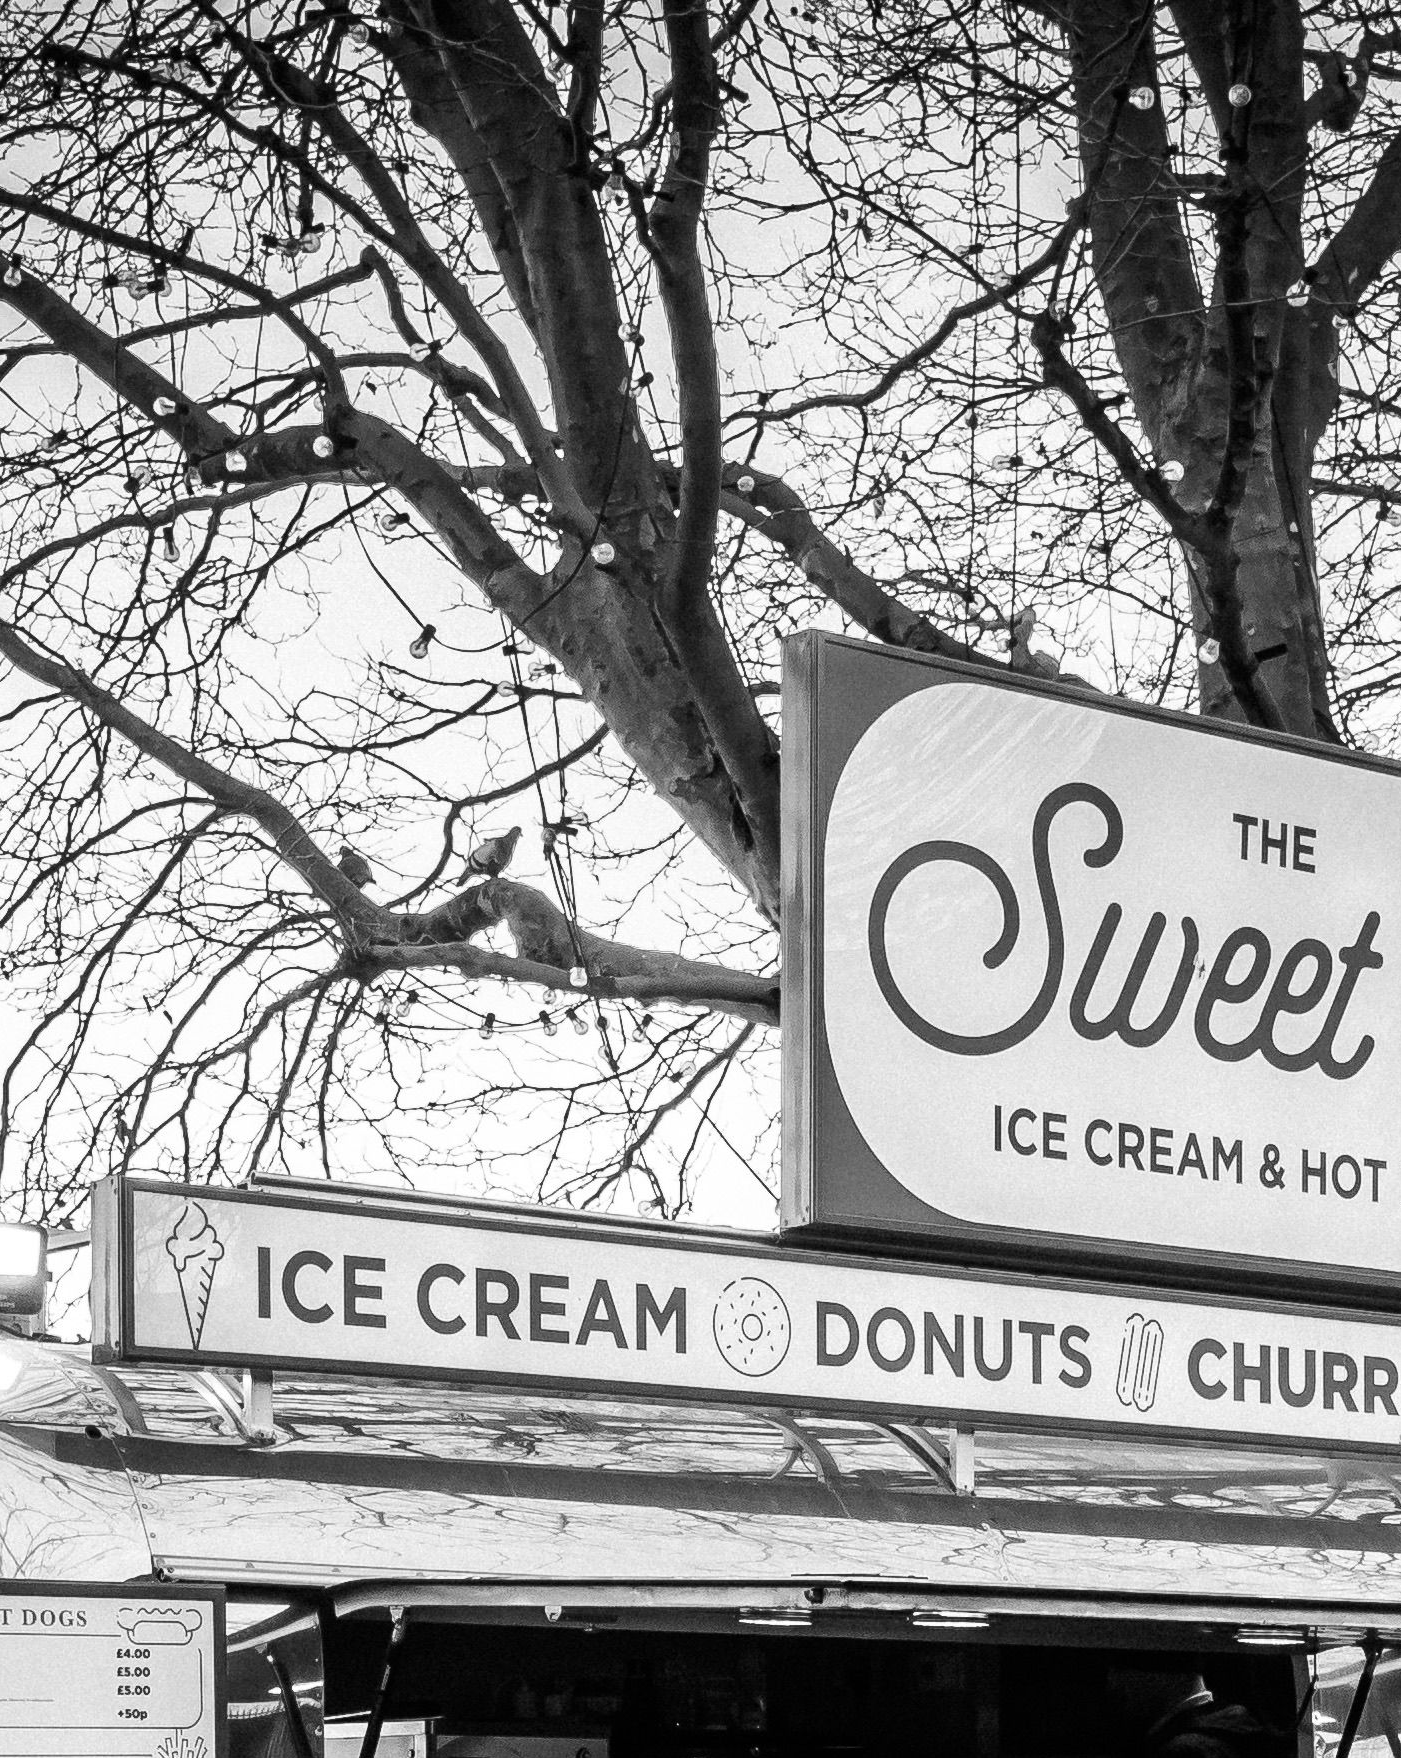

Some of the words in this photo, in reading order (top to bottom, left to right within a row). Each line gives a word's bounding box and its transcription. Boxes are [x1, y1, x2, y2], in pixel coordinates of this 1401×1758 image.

[1233, 813, 1317, 874] THE
[868, 782, 1383, 1081] Sweet
[994, 1104, 1066, 1160] ICE
[1084, 1121, 1244, 1183] CREAM
[1260, 1142, 1285, 1189] &
[1301, 1149, 1387, 1202] HOT
[257, 1246, 388, 1329] ICE
[417, 1263, 689, 1354] CREAM
[816, 1302, 1093, 1389] DONUTS
[21, 1610, 88, 1627] DOGS
[116, 1648, 150, 1660] £4.00
[116, 1667, 150, 1678] £5.00
[117, 1685, 150, 1696] £5.00
[117, 1708, 148, 1721] +50p
